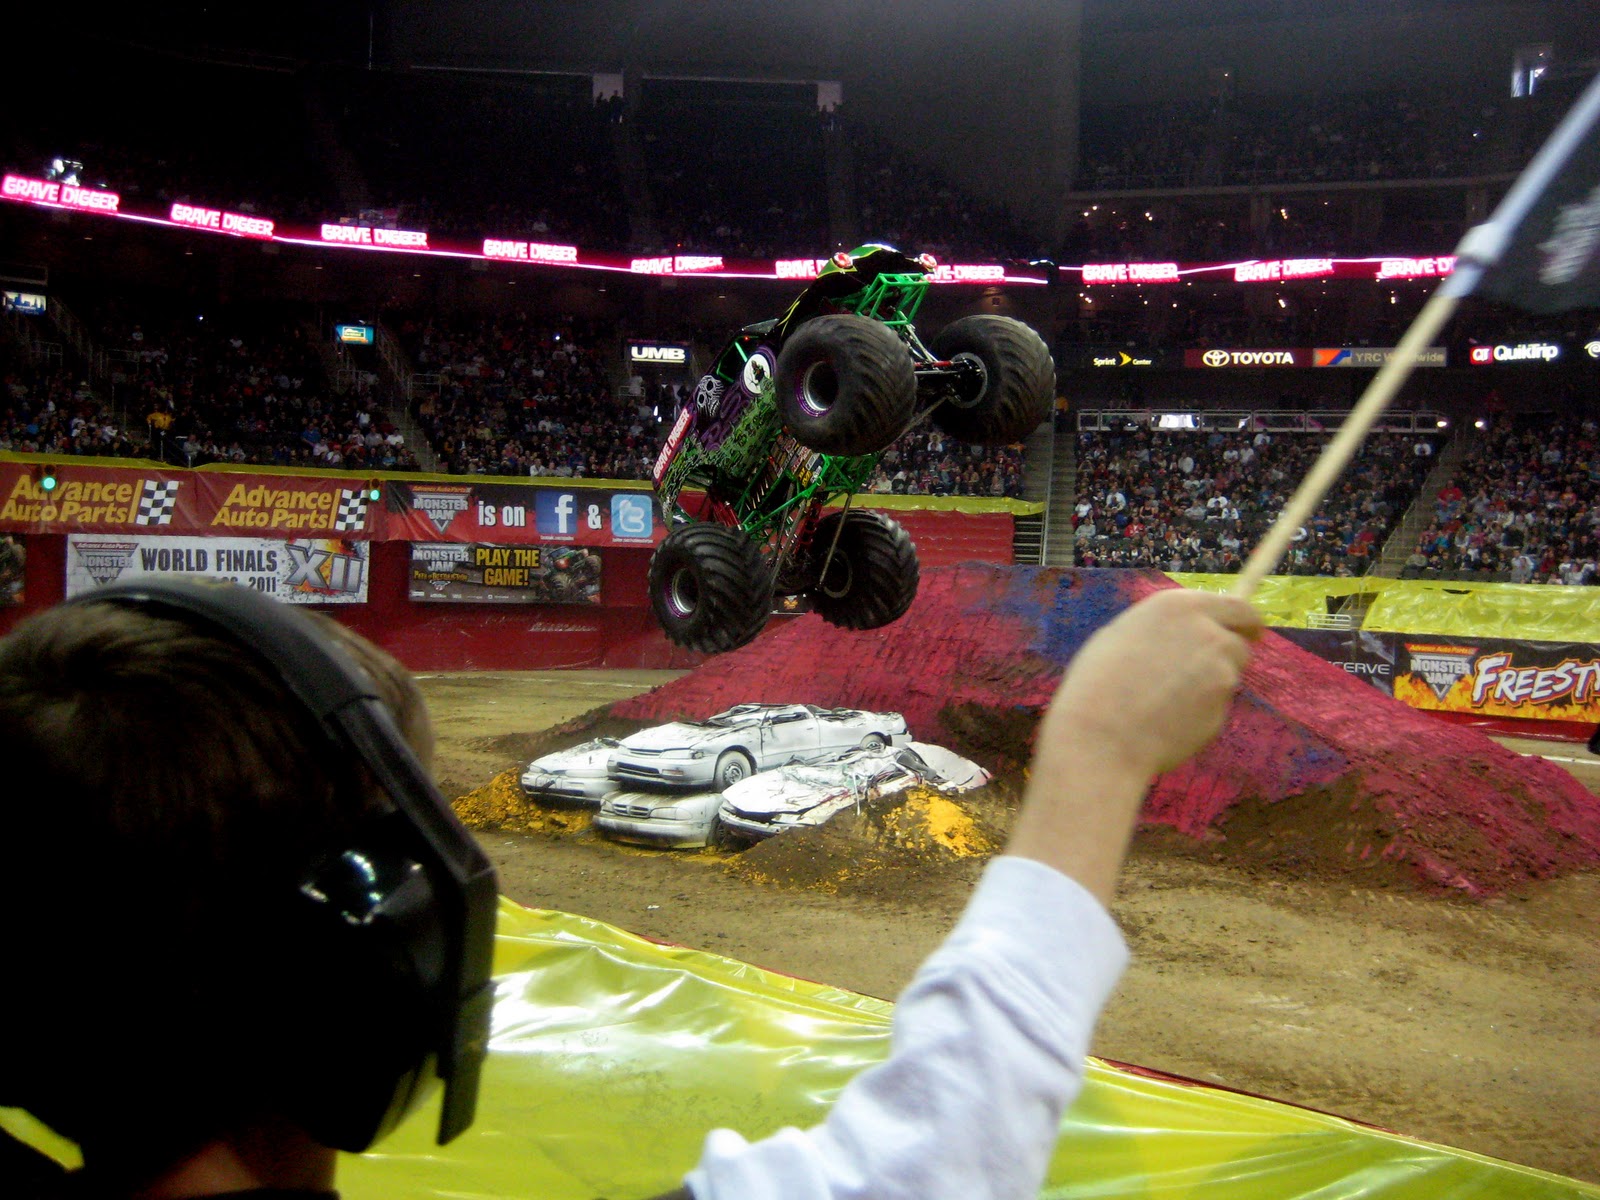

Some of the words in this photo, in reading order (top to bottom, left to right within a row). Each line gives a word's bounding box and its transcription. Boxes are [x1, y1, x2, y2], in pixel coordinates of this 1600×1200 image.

[2, 176, 59, 200] GRAVE
[61, 186, 119, 210] DIGGER
[171, 204, 220, 226] GRAVE
[222, 213, 274, 236] DIGGER
[322, 224, 371, 243] GRAVE
[374, 229, 428, 246] DIGGER
[484, 239, 527, 258] GRAVE
[531, 243, 577, 262] DIGGER
[631, 257, 672, 273] GRAVE
[776, 260, 816, 277] GRAVE
[953, 265, 1004, 279] DIGGER
[1083, 264, 1127, 281] GRAVE
[1129, 263, 1178, 280] DIGGER
[1235, 261, 1280, 281] GRAVE
[1282, 259, 1332, 275] DIGGER
[1380, 258, 1435, 277] GRAVE
[631, 346, 686, 360] UMB
[1231, 352, 1294, 364] TOYOTA
[1356, 353, 1381, 362] YRC
[1494, 343, 1558, 361] QuikTrip
[1093, 357, 1116, 367] Sprint
[1132, 358, 1152, 366] Center
[653, 443, 672, 479] GRAVE
[667, 408, 690, 448] DIGGER
[11, 475, 133, 503] Advance
[223, 484, 332, 510] Advance
[0, 500, 57, 521] Auto
[59, 501, 129, 524] Parts
[413, 499, 469, 511] MONSTER
[211, 507, 269, 528] Auto
[270, 508, 329, 529] Parts
[427, 510, 455, 520] JAM
[478, 501, 497, 526] is
[502, 505, 526, 527] on
[587, 504, 602, 529] &
[77, 556, 133, 568] MONSTER
[141, 548, 208, 571] WORLD
[216, 550, 278, 572] FINALS
[412, 550, 469, 561] MONSTER
[476, 548, 511, 567] PLAY
[514, 549, 540, 567] THE
[427, 561, 454, 572] JAM
[248, 576, 277, 592] 2011
[484, 568, 530, 586] GAME!
[1410, 659, 1471, 674] MONSTER
[1424, 672, 1456, 685] JAM
